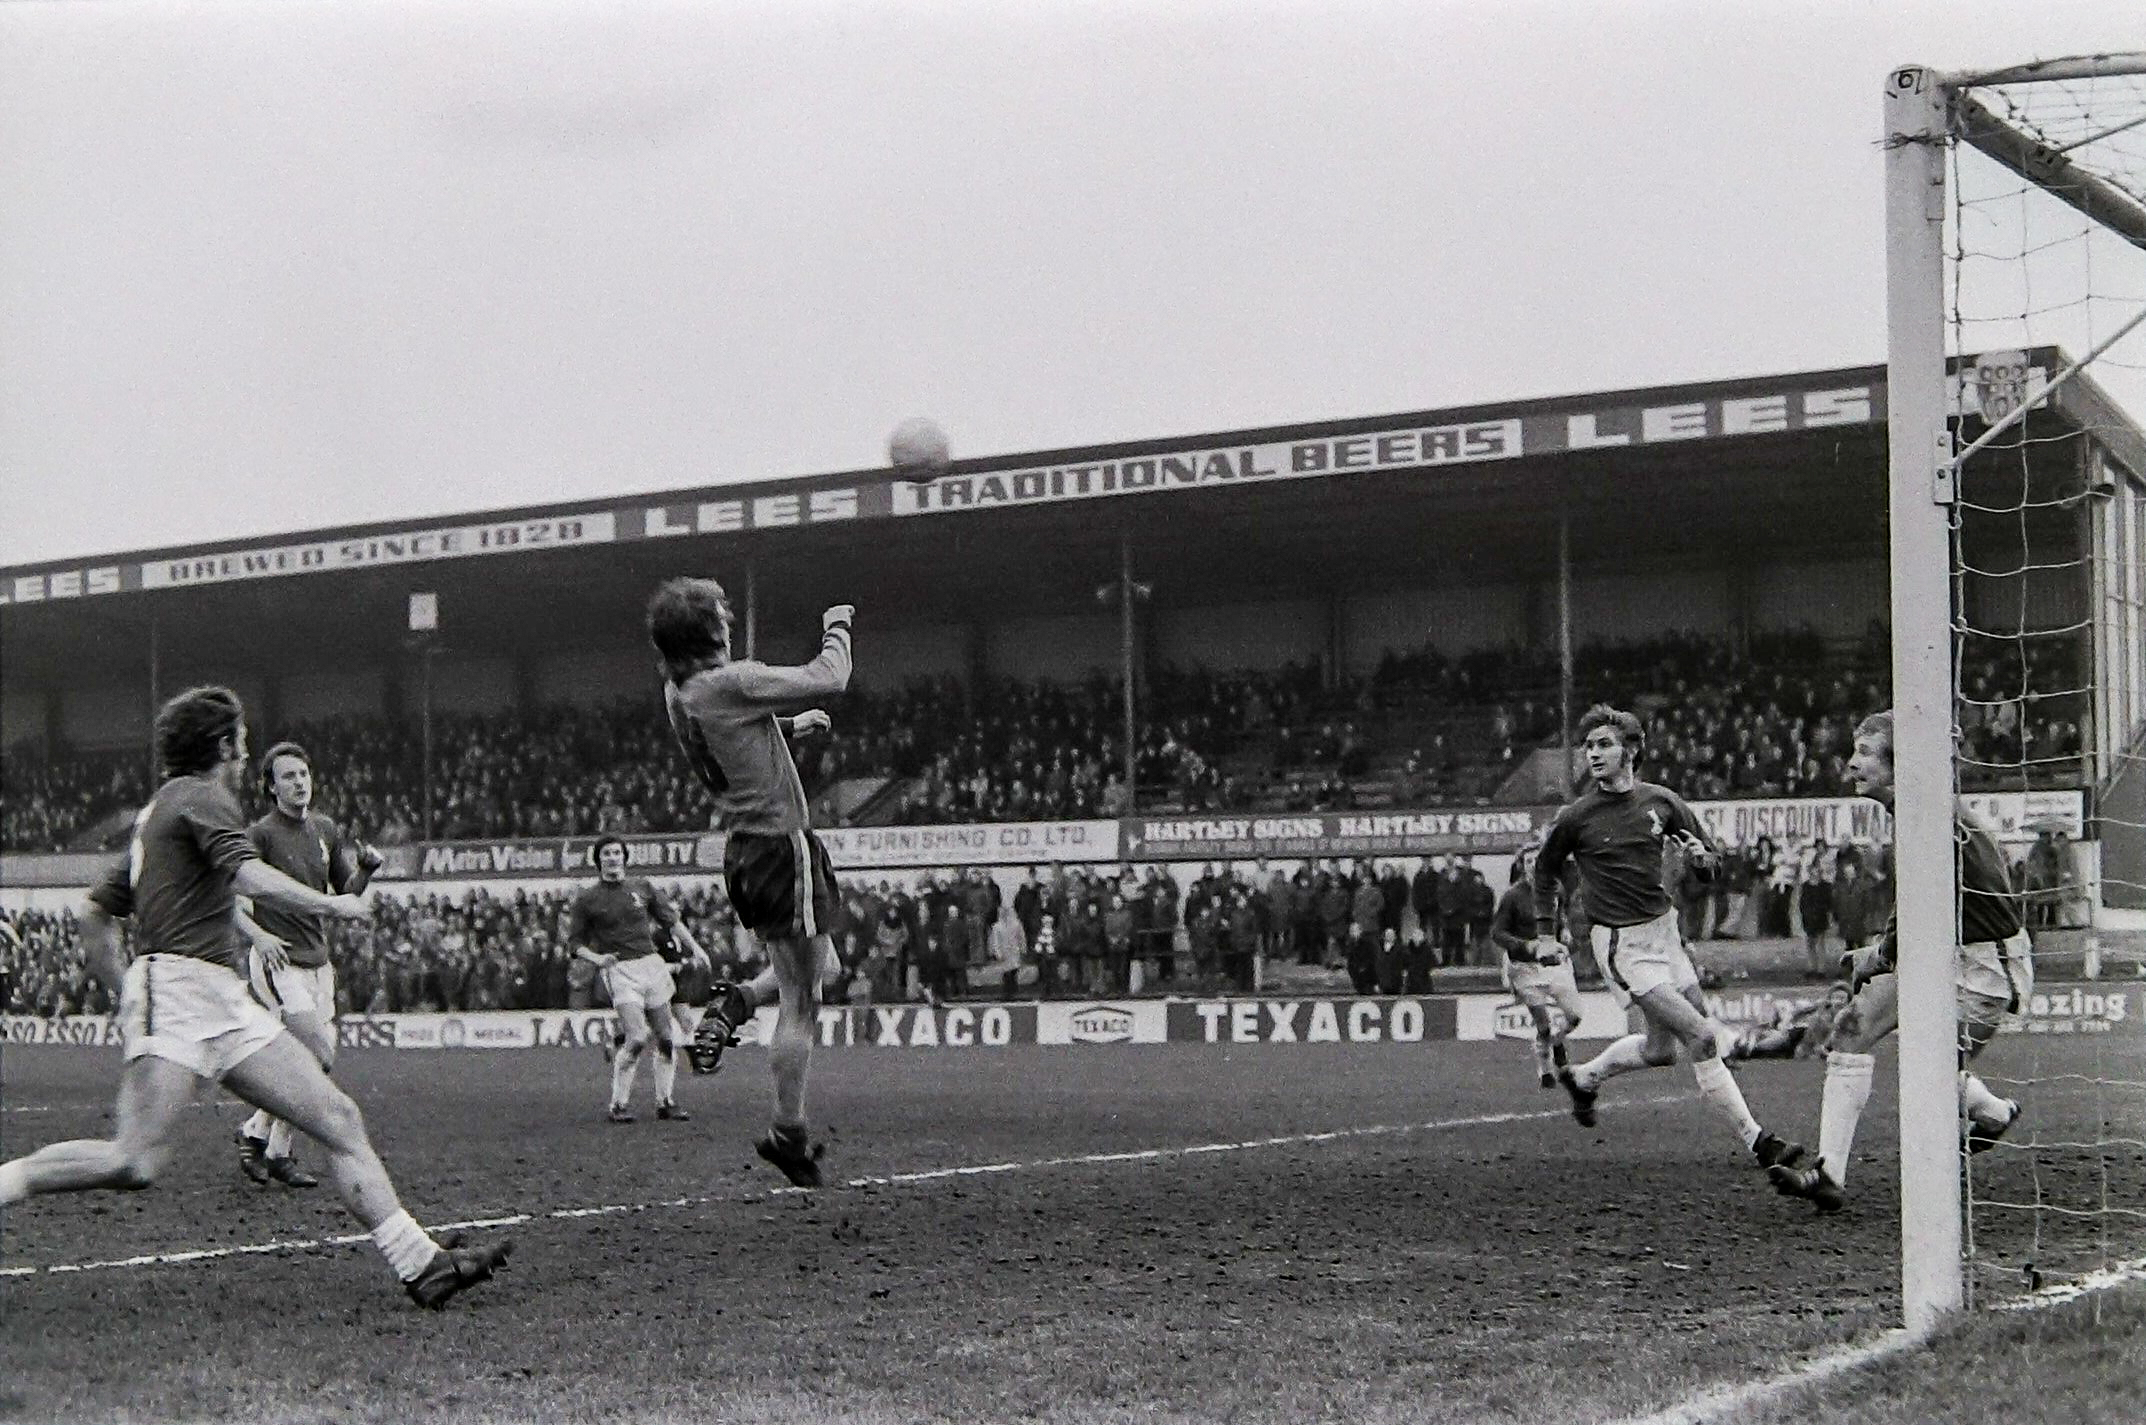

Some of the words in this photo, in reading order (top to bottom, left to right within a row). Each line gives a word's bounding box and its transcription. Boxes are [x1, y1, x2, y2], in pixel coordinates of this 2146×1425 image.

[1567, 387, 1871, 449] LEES
[906, 450, 1276, 509] TRADITIONAL
[1291, 424, 1505, 473] BEERS
[645, 488, 858, 537] LEES
[339, 527, 466, 562] SINCE
[0, 565, 120, 605] EES
[855, 828, 986, 850] FURNISHING
[1144, 820, 1250, 842] HARTLEY
[1253, 817, 1324, 839] SIGNS
[1339, 814, 1454, 837] HARTLEY
[1457, 811, 1532, 834] SIGNS
[1736, 803, 1838, 839] DISCOUNT
[666, 842, 694, 865] TV
[1197, 1001, 1426, 1043] TEXACO
